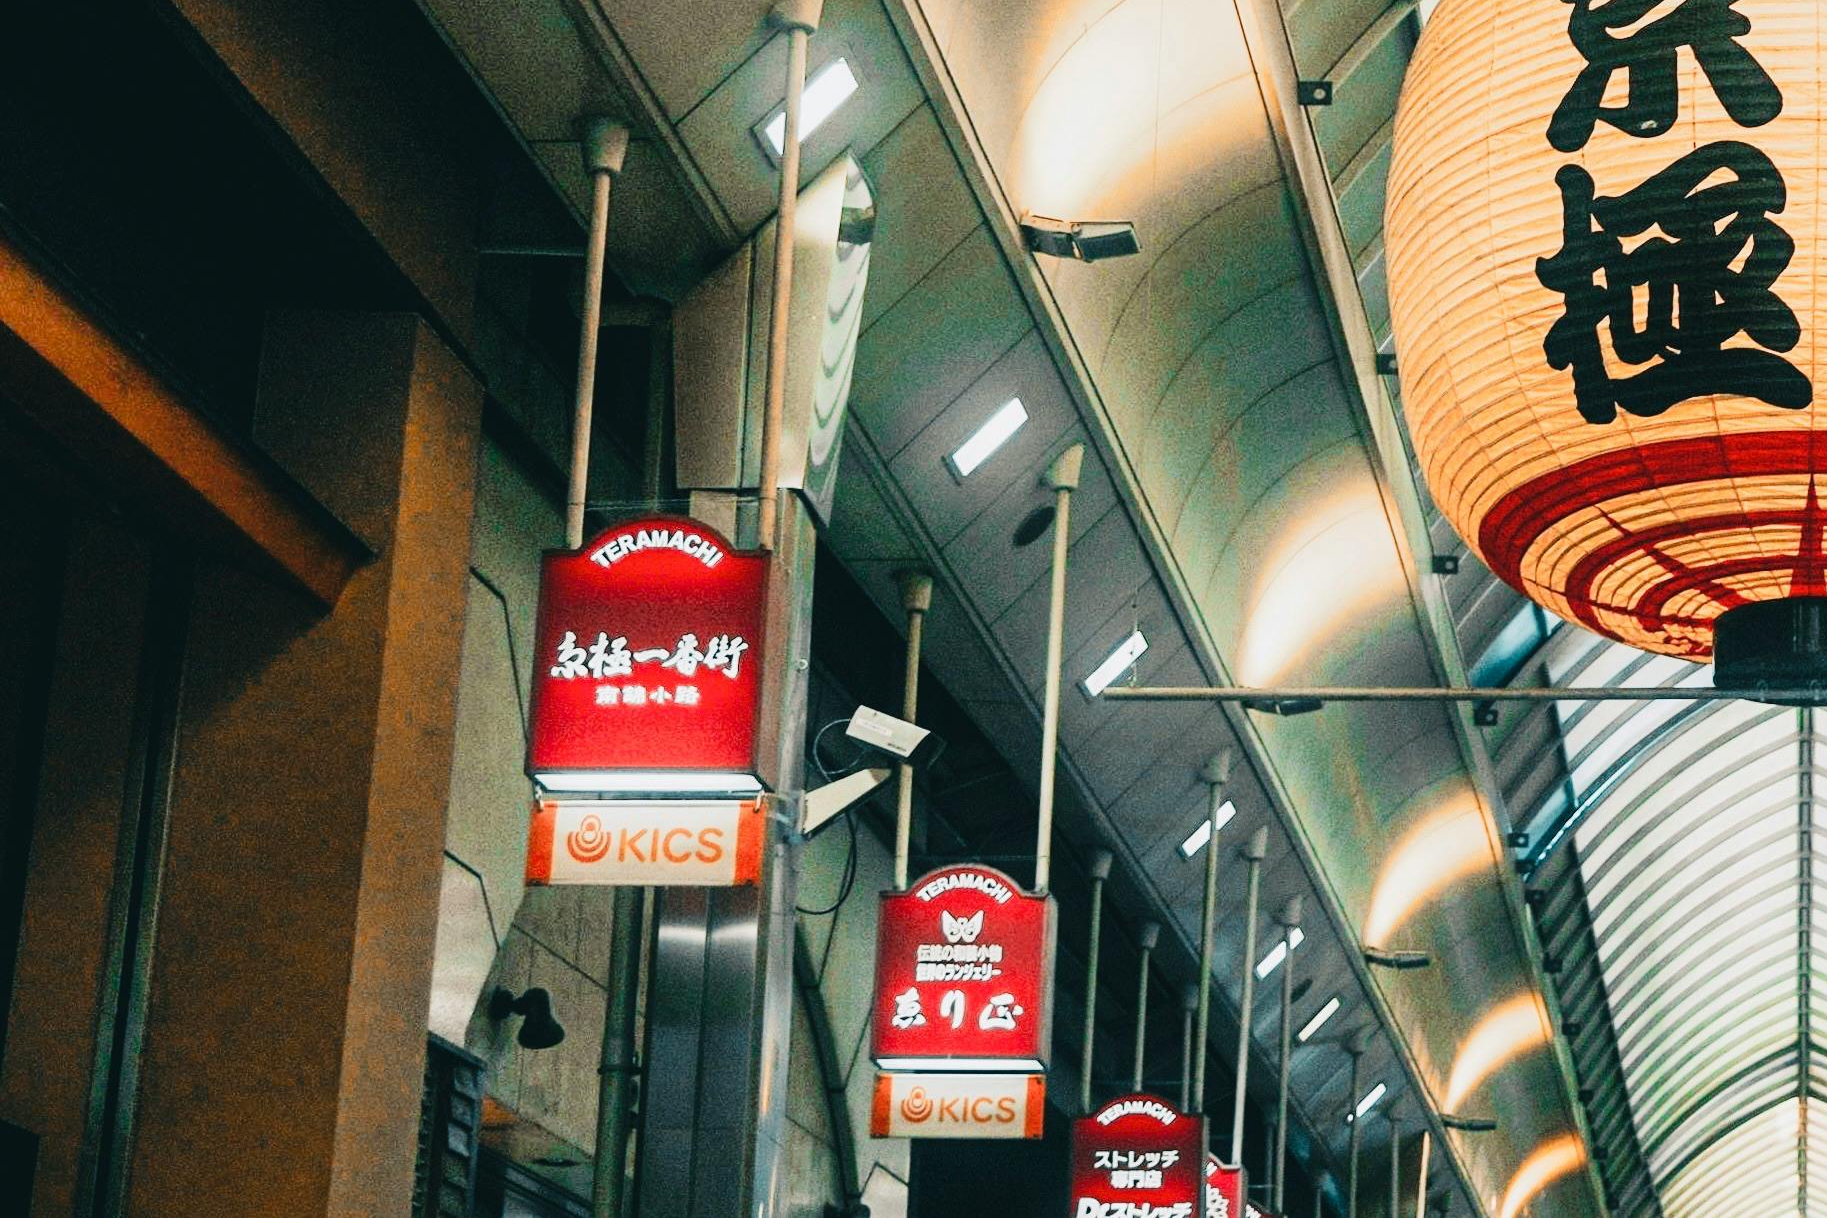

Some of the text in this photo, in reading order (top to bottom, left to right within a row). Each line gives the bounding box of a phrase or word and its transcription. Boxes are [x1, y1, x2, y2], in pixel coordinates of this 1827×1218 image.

[590, 529, 724, 569] TERAMACHI
[551, 631, 748, 680] 京極一番街
[618, 827, 724, 864] KICS
[916, 873, 1014, 904] TERAMACHI
[938, 1097, 1016, 1124] KICS
[1096, 1100, 1177, 1126] TERAMACHI
[1093, 1150, 1179, 1169] ストレッチ
